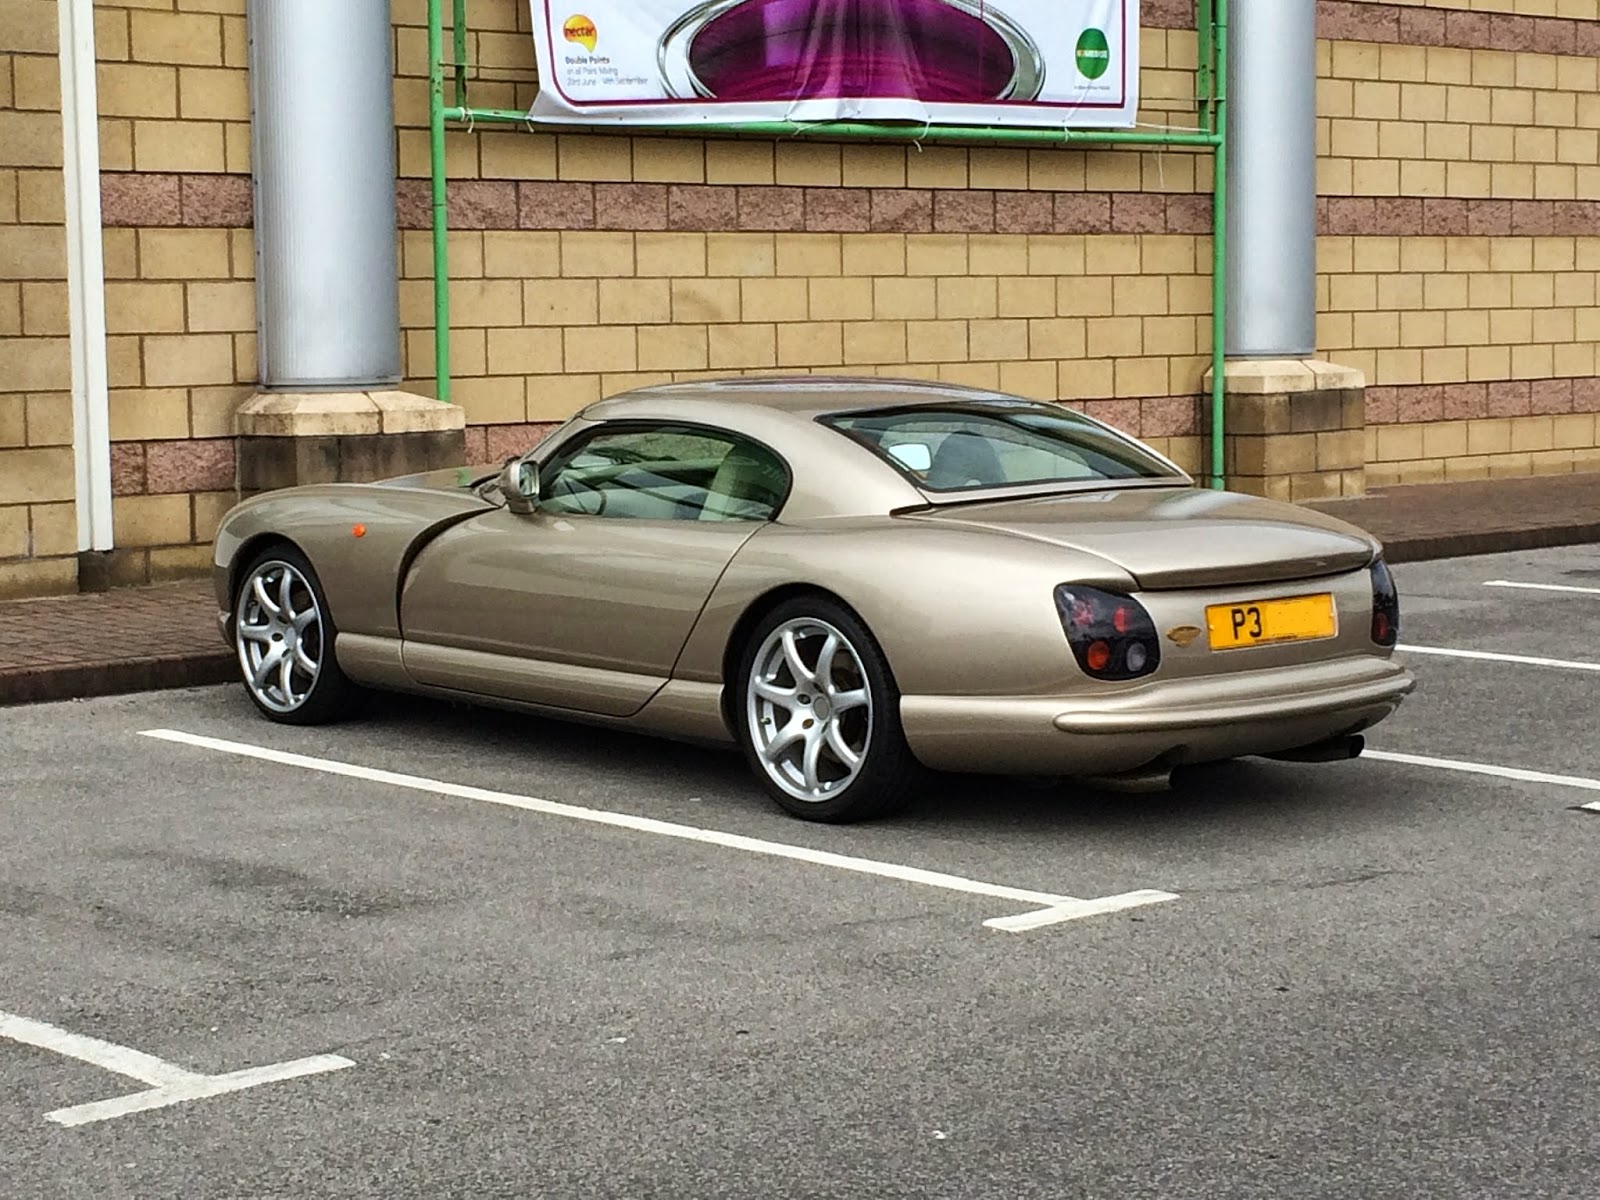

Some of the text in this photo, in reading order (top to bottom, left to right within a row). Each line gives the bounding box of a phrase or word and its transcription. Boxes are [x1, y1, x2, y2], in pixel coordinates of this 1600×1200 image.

[565, 27, 594, 37] nectar
[565, 56, 610, 65] Double Points
[1231, 607, 1262, 640] P3
